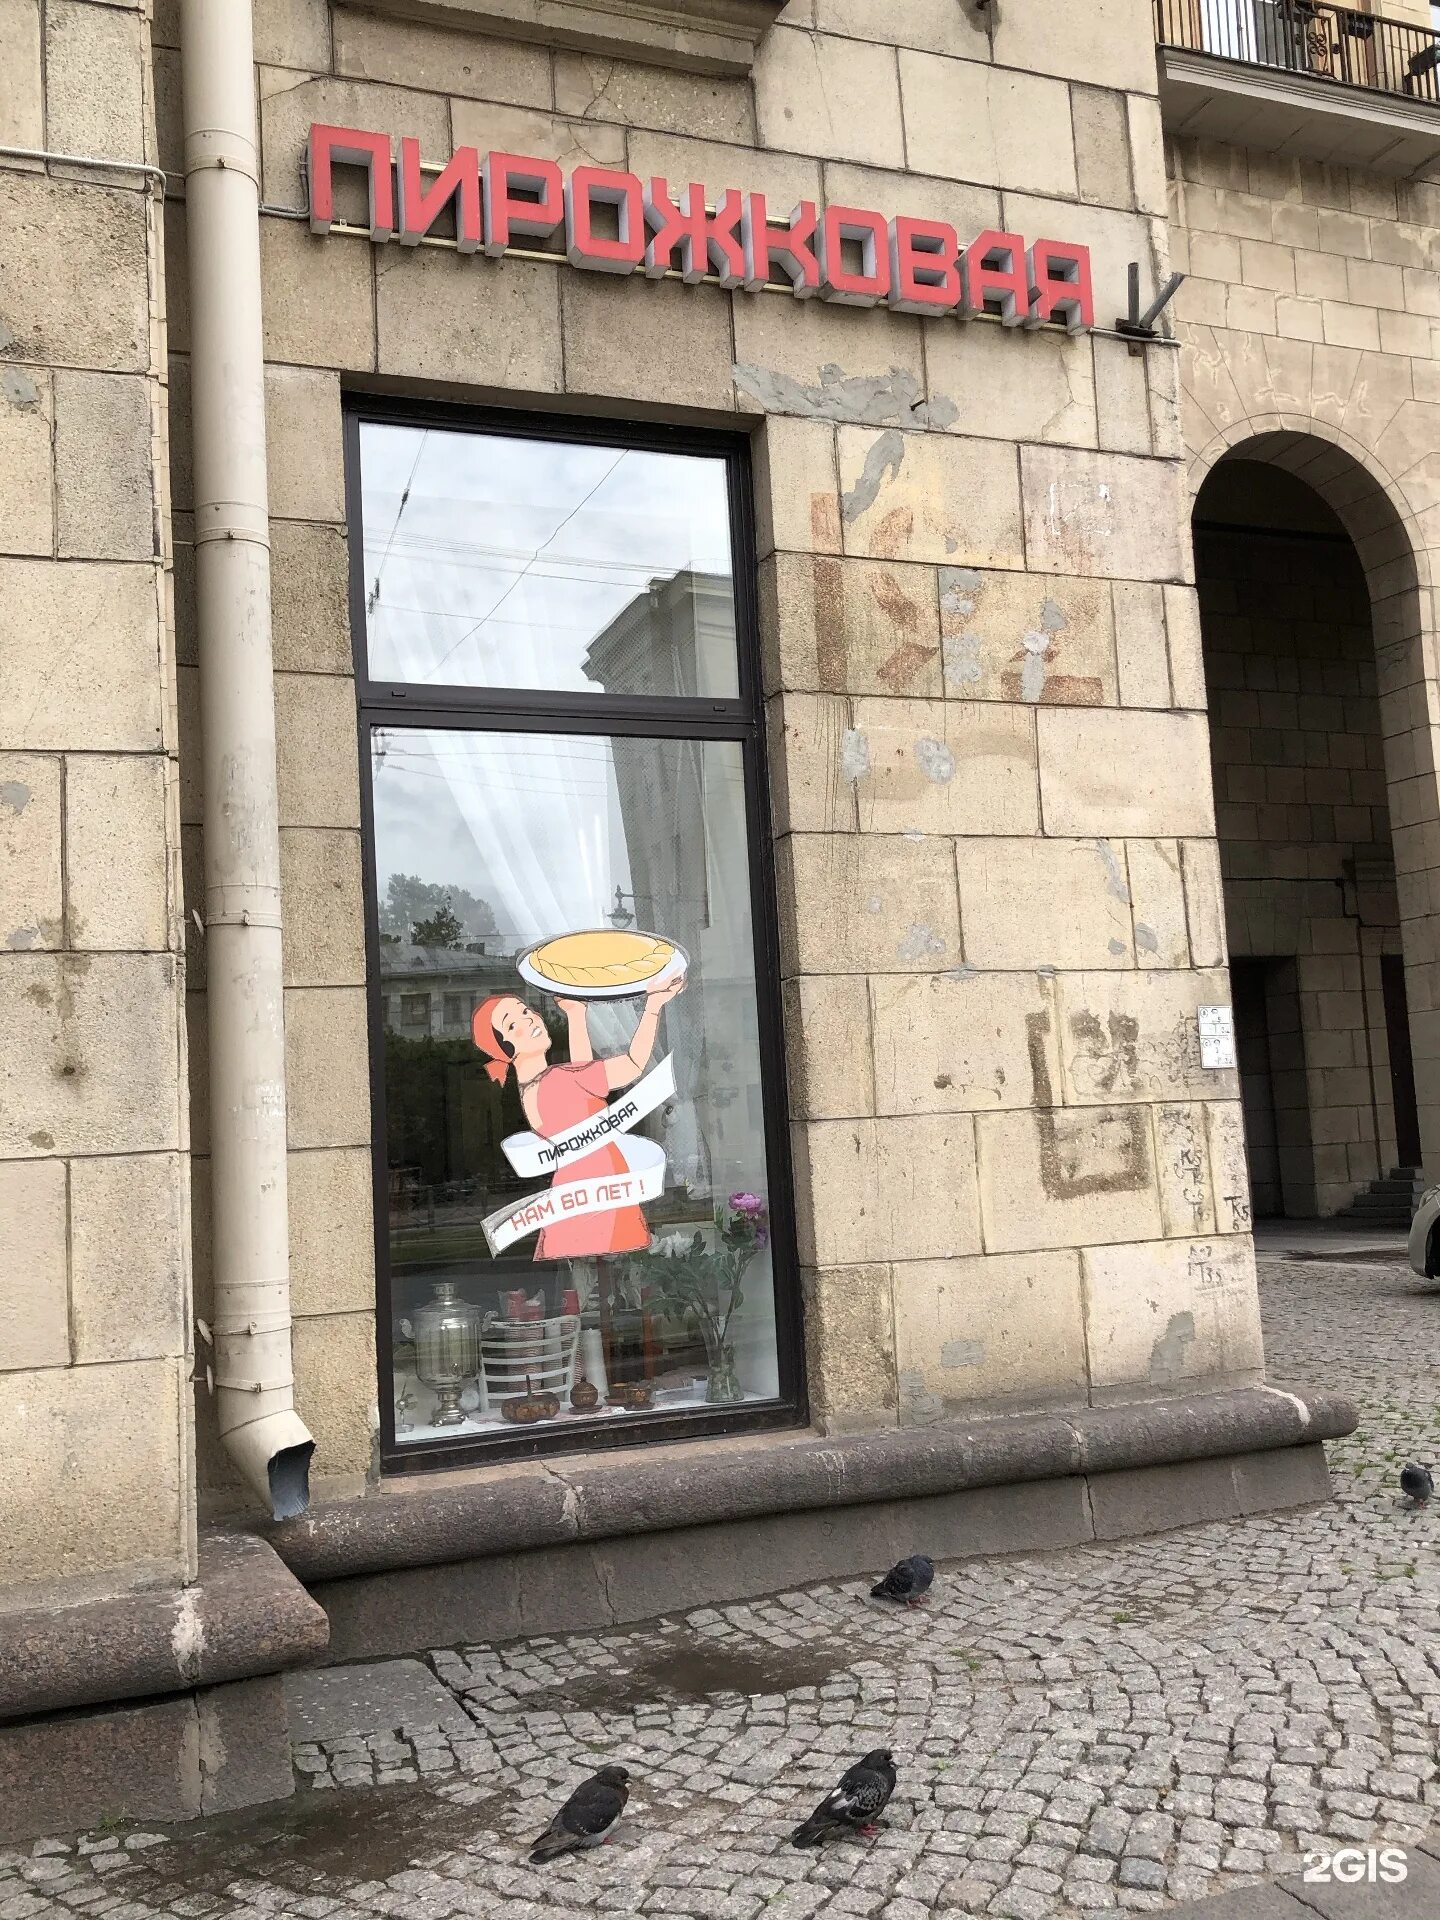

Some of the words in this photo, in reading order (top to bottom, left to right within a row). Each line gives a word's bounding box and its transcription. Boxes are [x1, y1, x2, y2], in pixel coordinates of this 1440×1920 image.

[309, 123, 1094, 336] ПИРОЖКОВАЯ
[537, 1101, 638, 1164] ПИРОЖКОВАЯ
[510, 1201, 555, 1230] НАМ
[561, 1189, 588, 1210] 60
[597, 1181, 632, 1203] ЛЕТ
